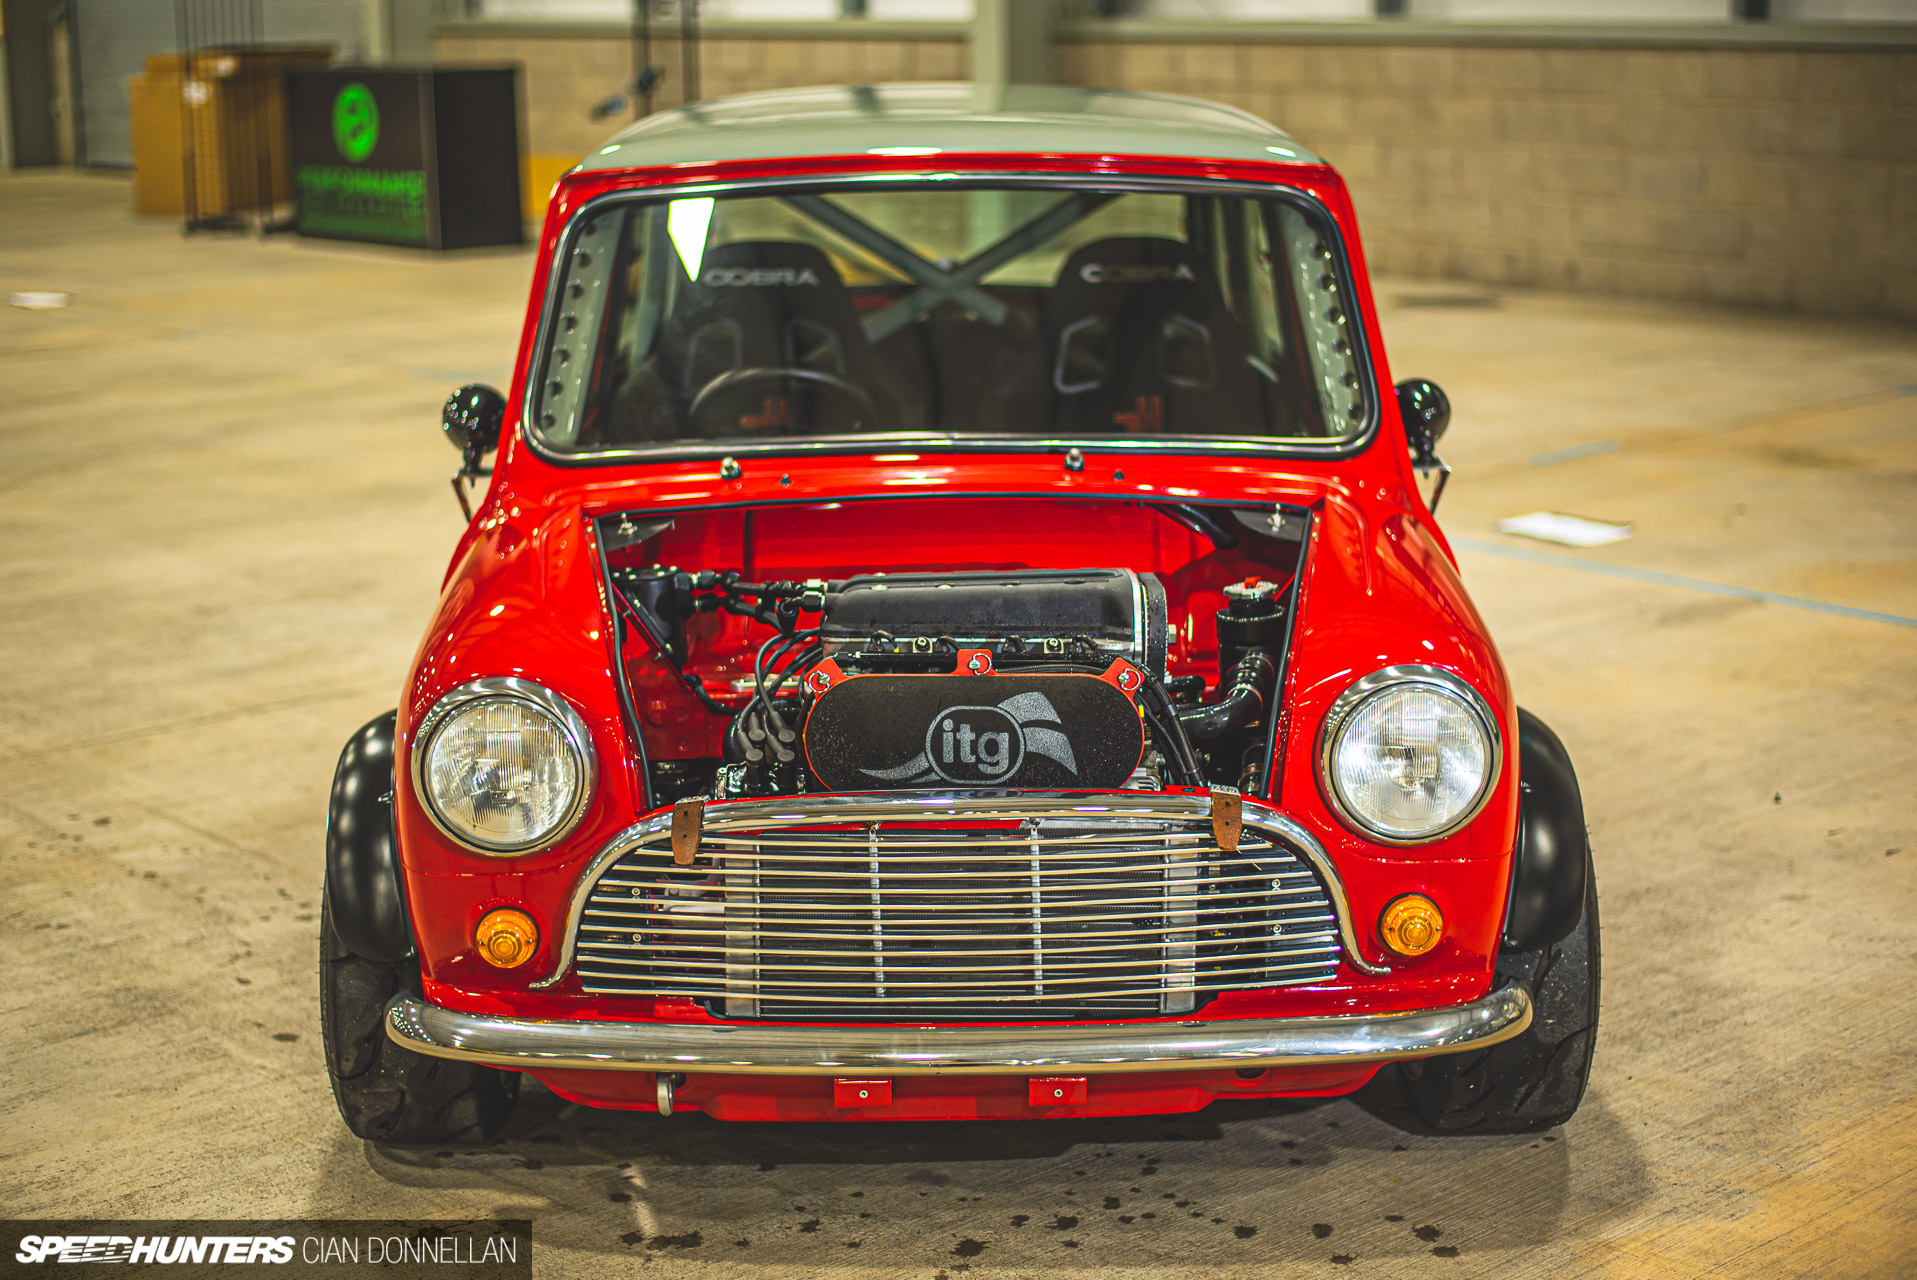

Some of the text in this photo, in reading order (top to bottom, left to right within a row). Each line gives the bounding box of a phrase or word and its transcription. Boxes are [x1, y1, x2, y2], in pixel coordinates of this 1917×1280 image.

[704, 267, 818, 287] COBRA
[1080, 263, 1196, 283] COBRA
[942, 718, 1009, 774] itg
